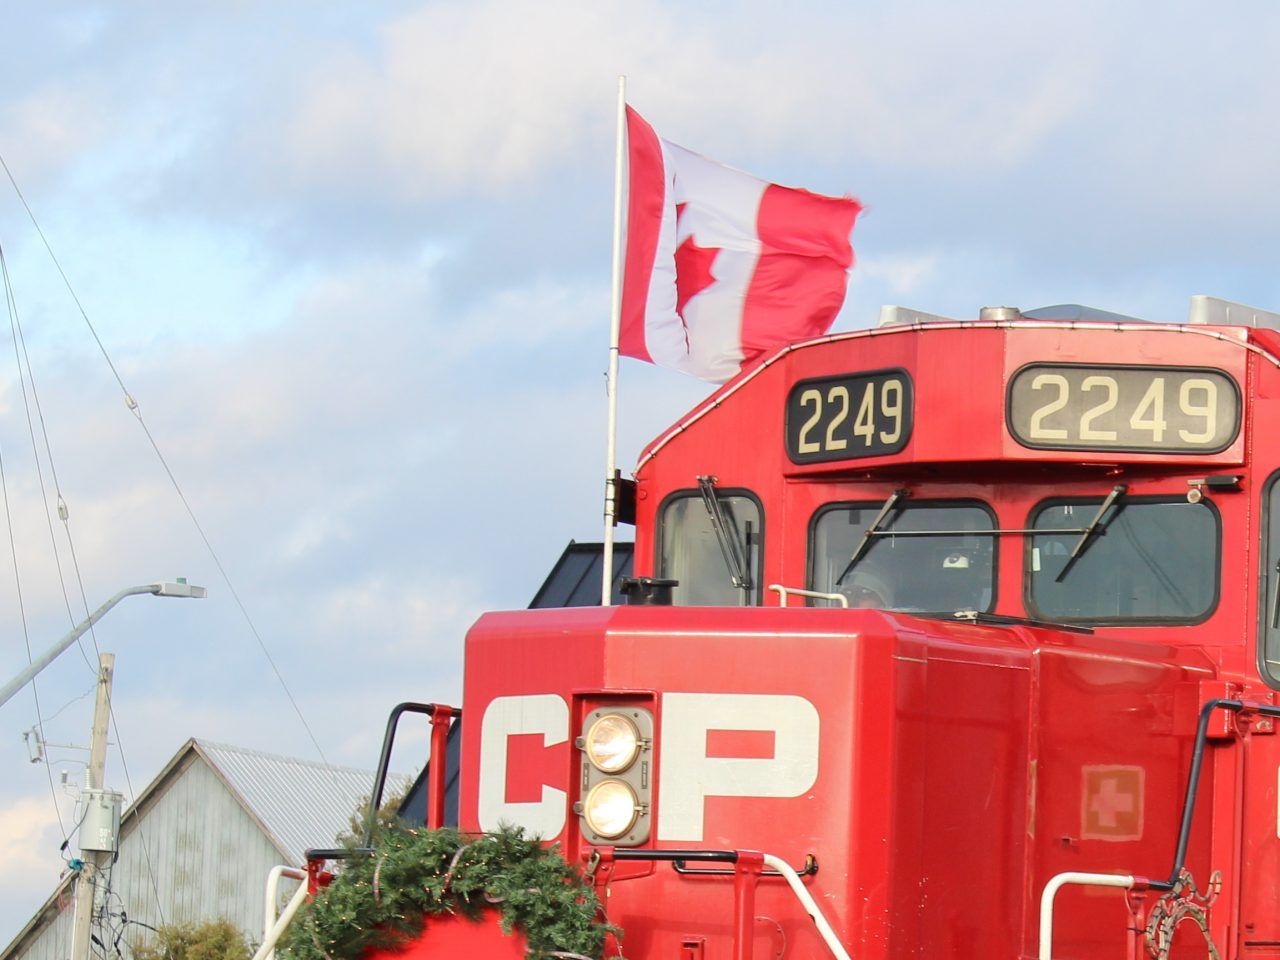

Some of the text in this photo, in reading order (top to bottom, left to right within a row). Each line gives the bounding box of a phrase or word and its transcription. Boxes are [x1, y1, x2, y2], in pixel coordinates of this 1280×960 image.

[799, 379, 903, 454] 2249
[1030, 374, 1217, 444] 2249
[478, 692, 820, 842] CP
